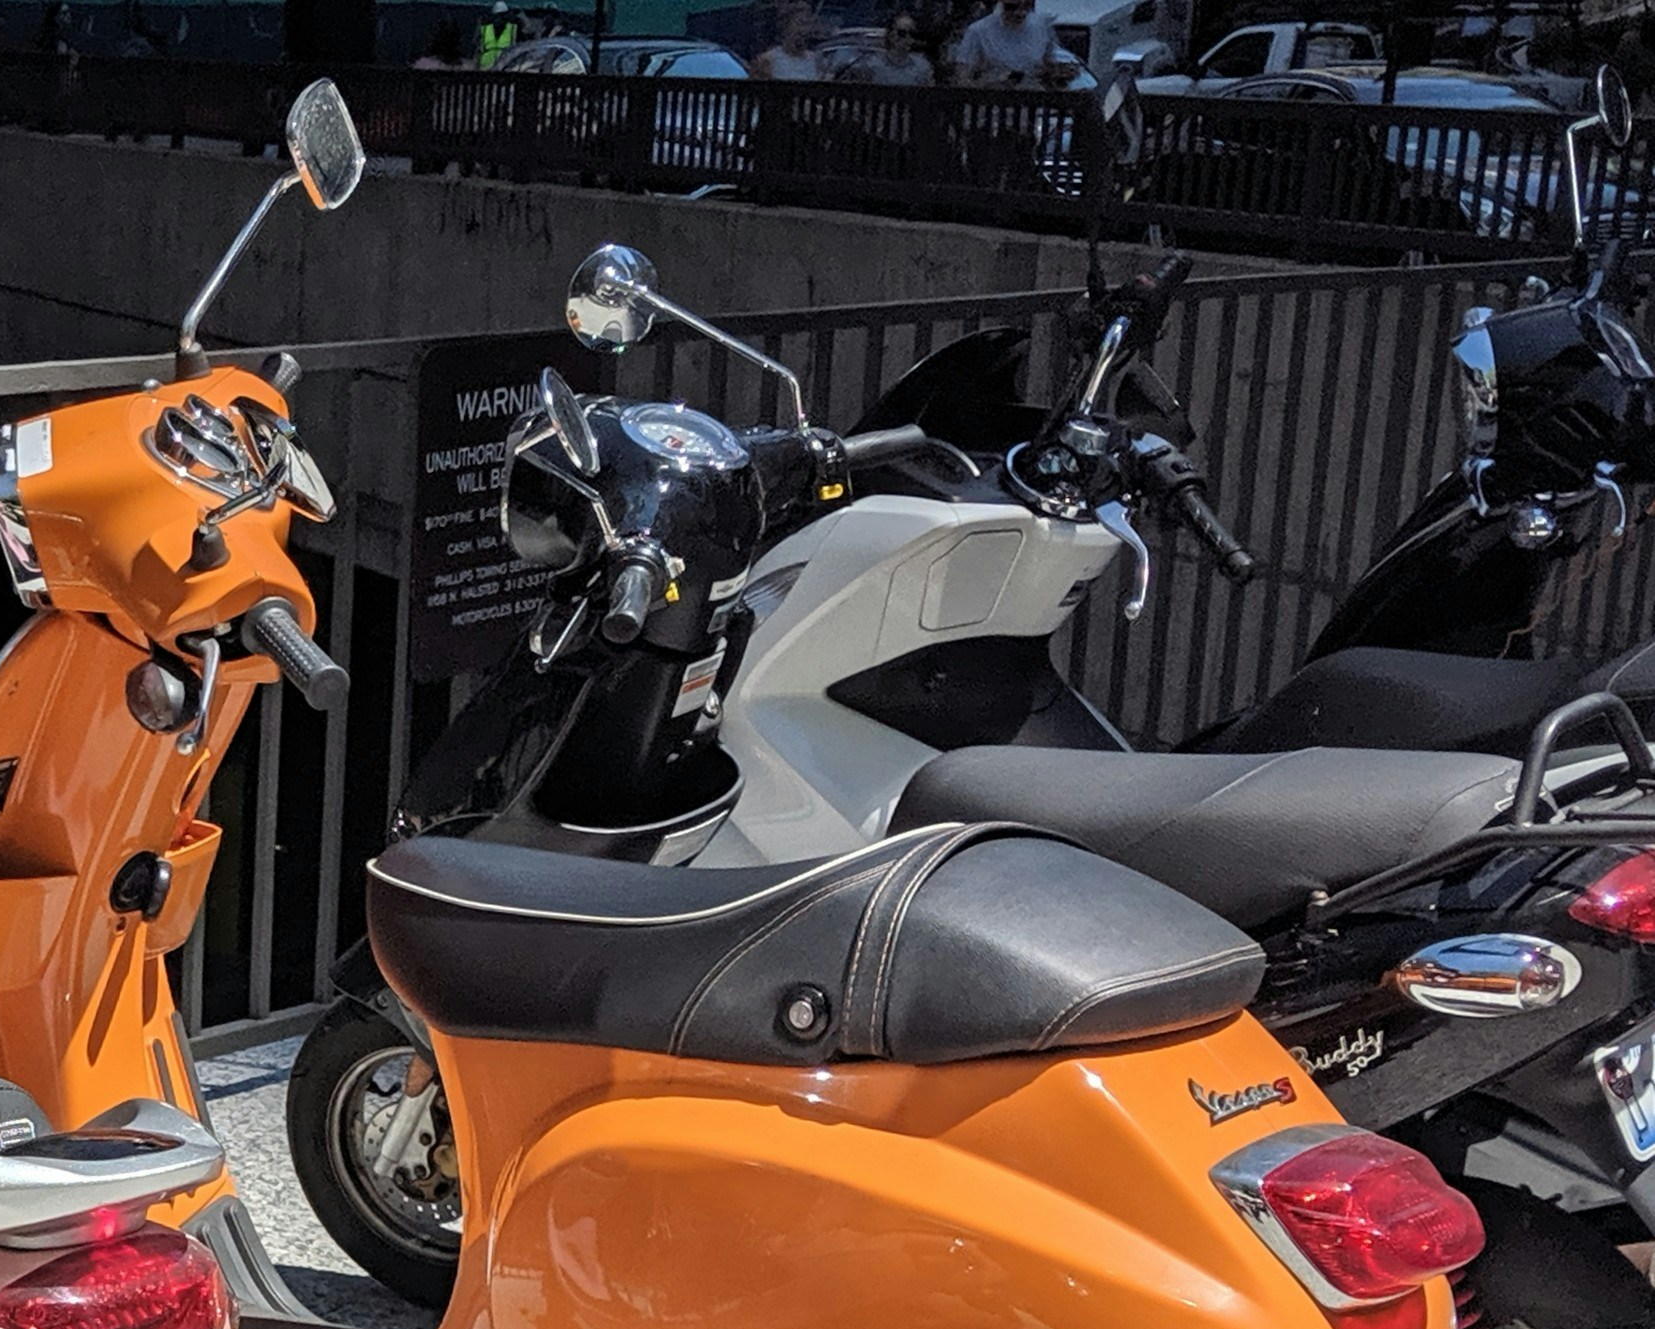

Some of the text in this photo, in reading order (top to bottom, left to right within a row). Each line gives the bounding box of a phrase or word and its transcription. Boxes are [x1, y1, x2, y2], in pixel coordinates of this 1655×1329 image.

[456, 384, 543, 421] WARNIN
[426, 441, 505, 473] UNAUTHORIZ
[456, 470, 486, 494] WILL
[1289, 1028, 1384, 1075] Buddy
[1346, 1056, 1369, 1077] 50
